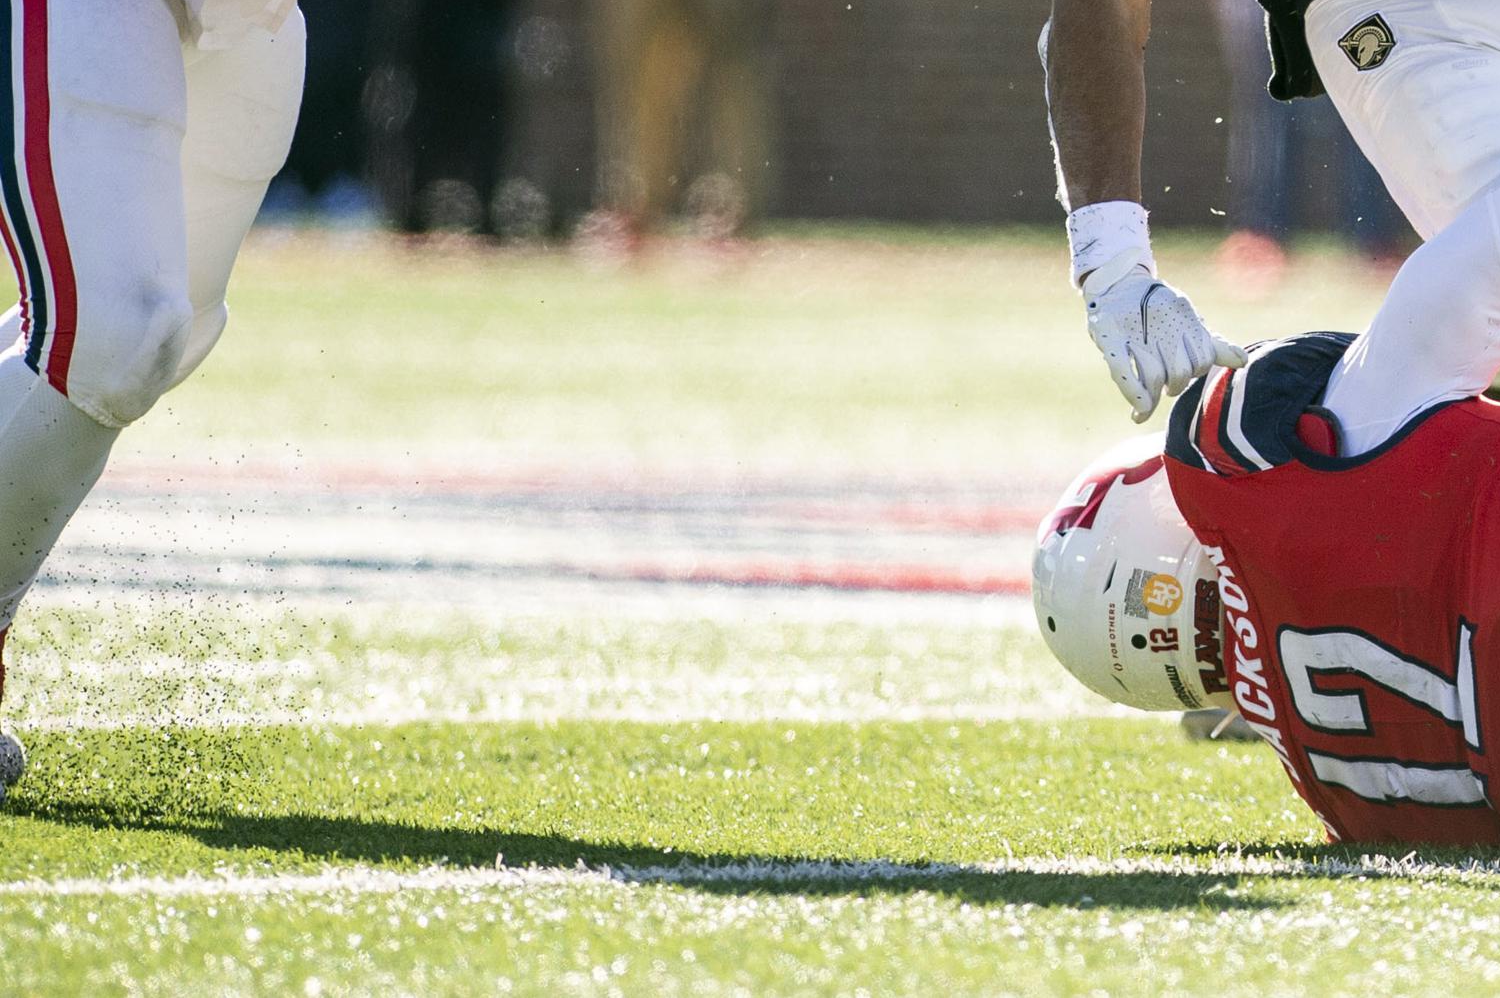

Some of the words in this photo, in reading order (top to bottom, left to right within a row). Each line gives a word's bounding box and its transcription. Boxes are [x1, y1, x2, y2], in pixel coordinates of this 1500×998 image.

[1149, 627, 1179, 653] 12
[1193, 578, 1231, 695] FLAMES
[1278, 616, 1488, 808] 12
